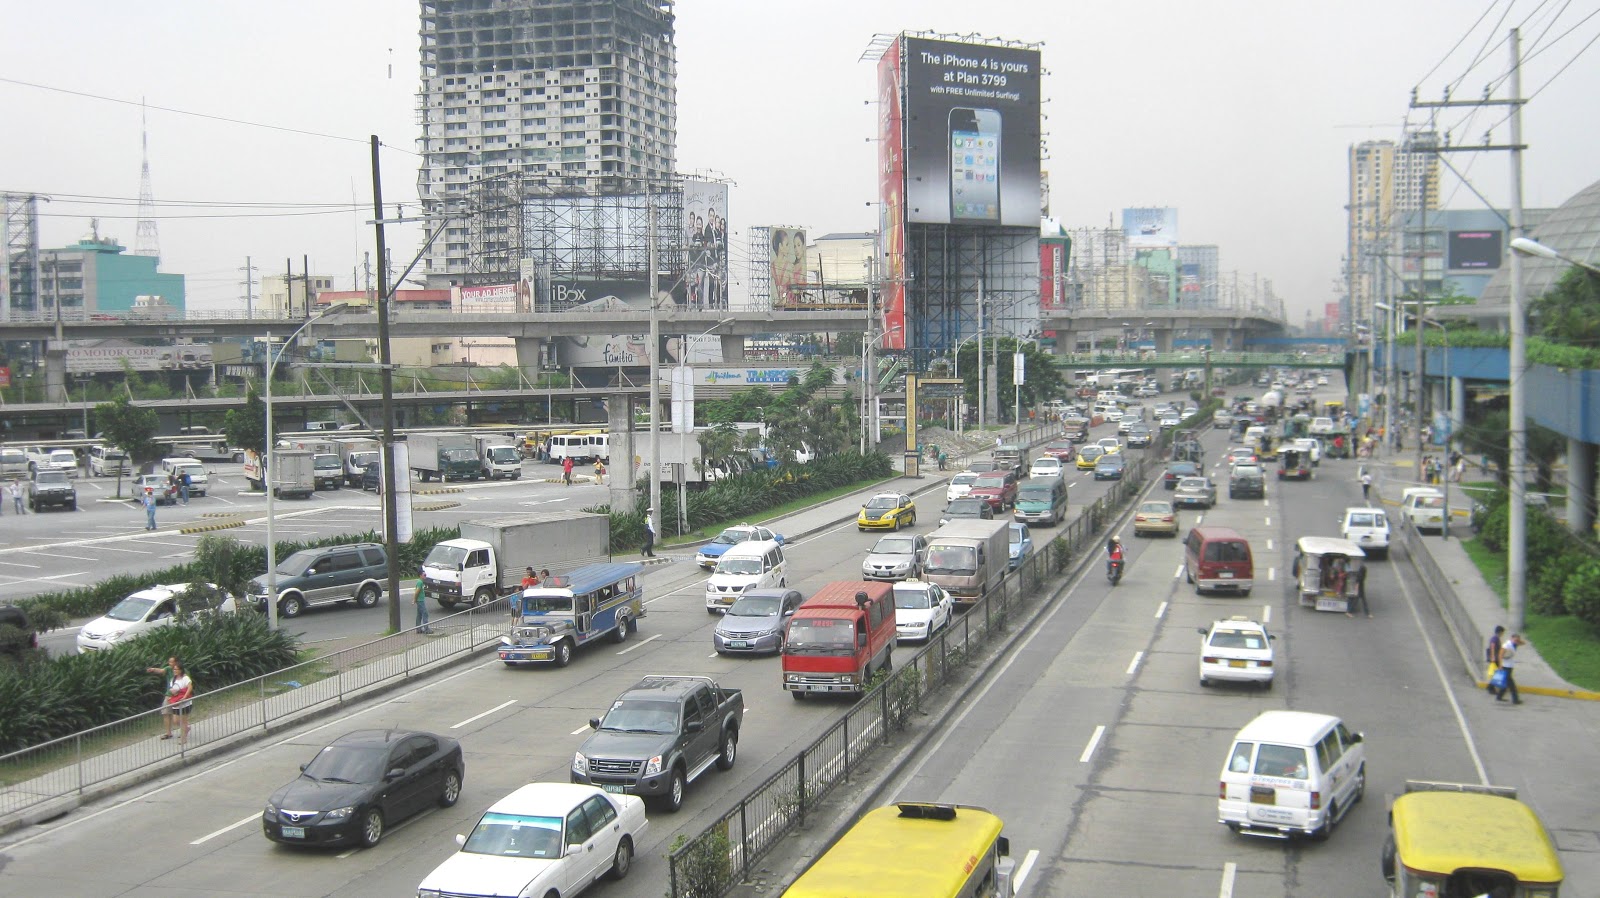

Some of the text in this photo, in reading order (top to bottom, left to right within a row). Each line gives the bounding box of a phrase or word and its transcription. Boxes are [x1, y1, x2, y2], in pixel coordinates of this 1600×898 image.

[920, 52, 1028, 73] The iPhone 4 is yours
[943, 71, 1007, 87] at Plan 3799
[930, 86, 1020, 101] with FREE Unlimited Surfing!
[462, 290, 480, 300] YOUR
[481, 288, 494, 298] AD
[84, 349, 123, 358] MOTOR
[603, 343, 633, 365] familia
